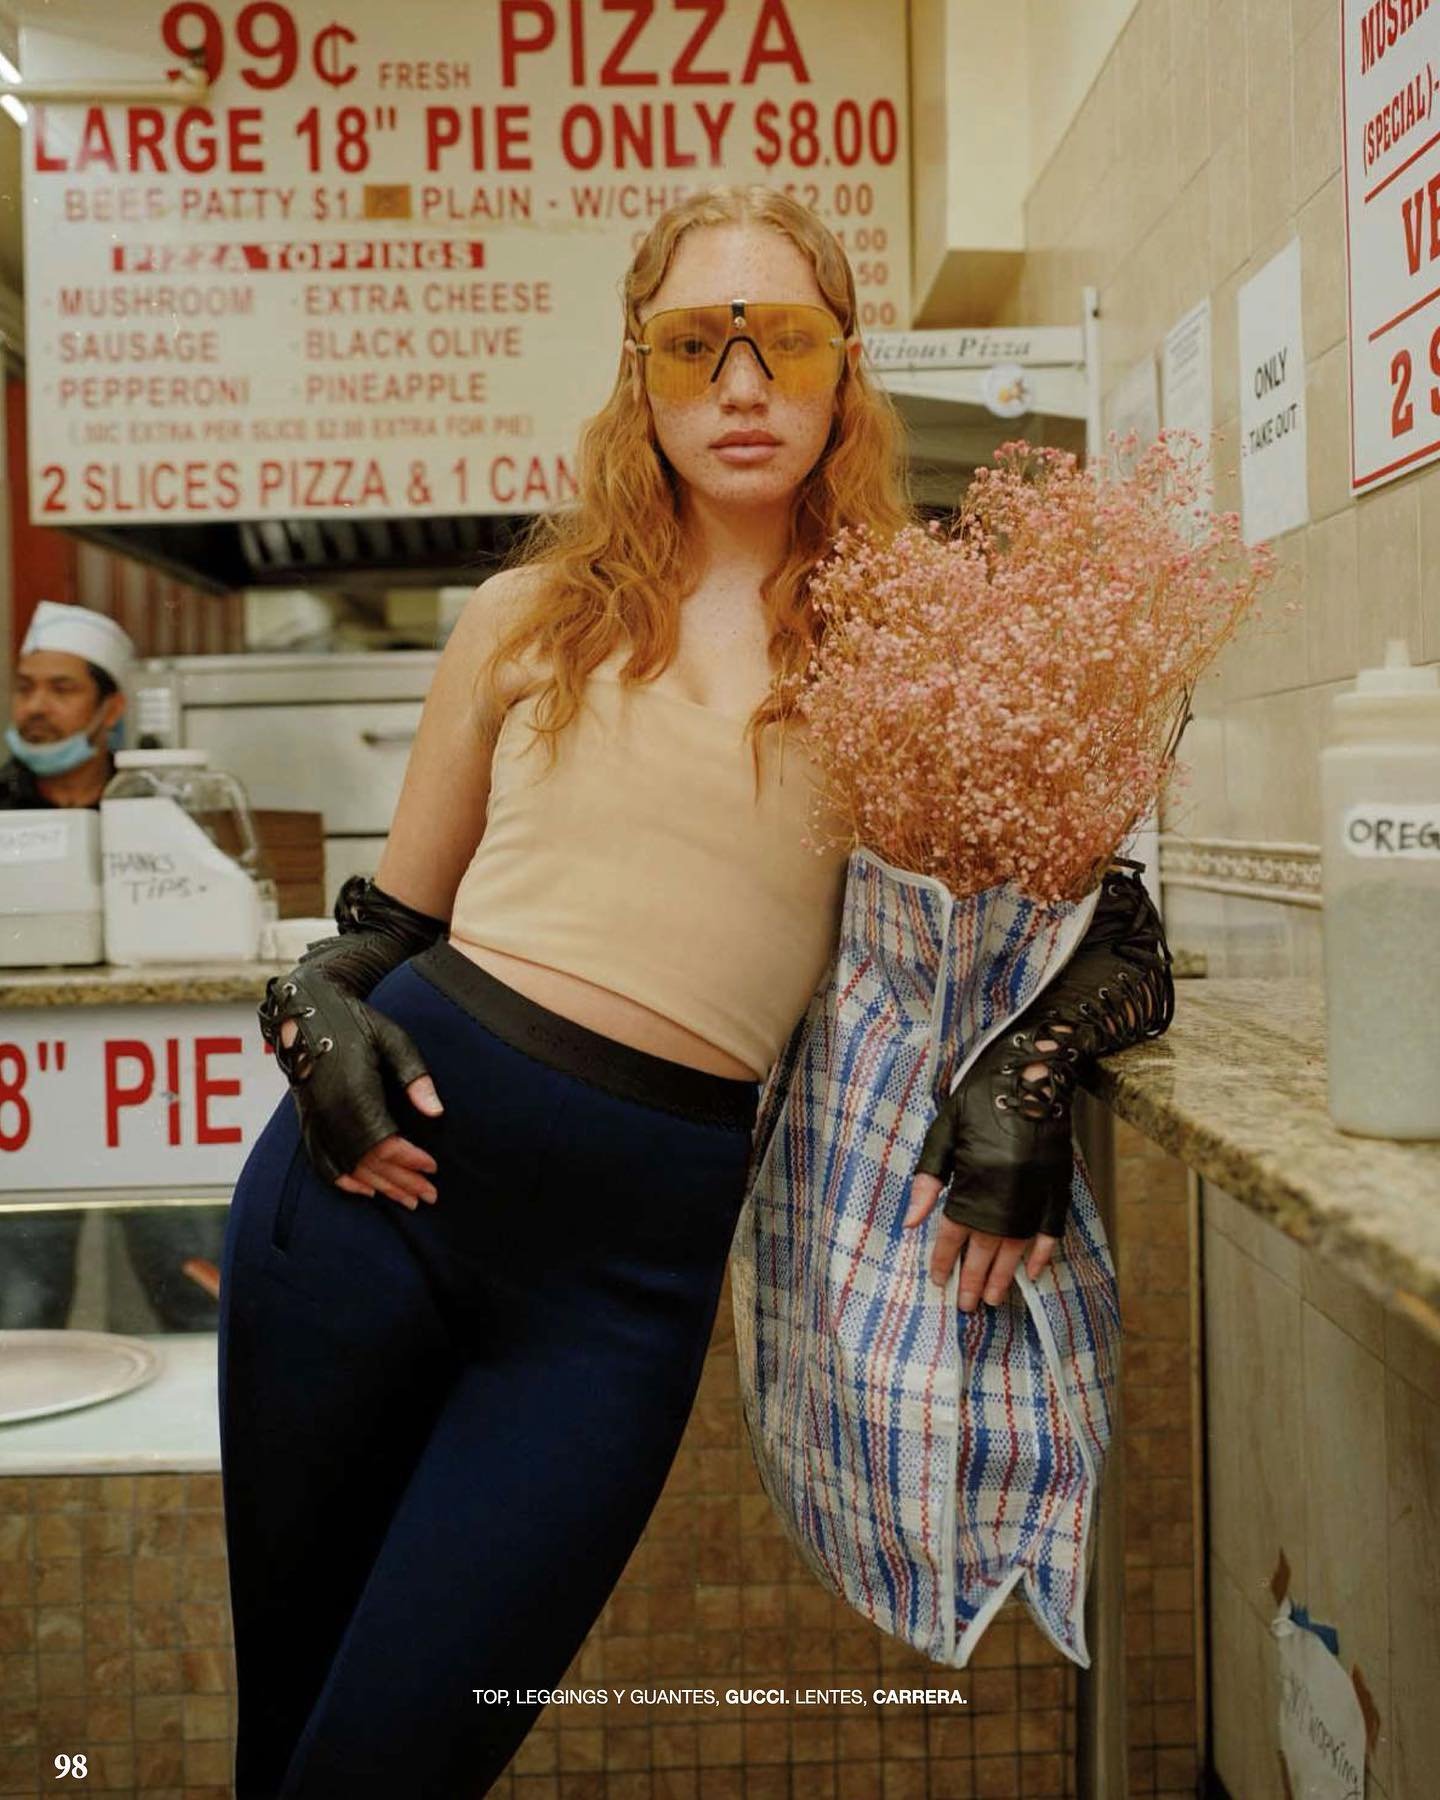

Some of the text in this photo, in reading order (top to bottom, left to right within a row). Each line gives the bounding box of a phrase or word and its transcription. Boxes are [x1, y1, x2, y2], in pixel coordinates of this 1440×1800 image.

[379, 62, 470, 88] FRESH
[501, 0, 810, 87] PIZZA
[34, 98, 898, 173] LARGE 18" PIE ONLY $8.00
[65, 188, 164, 222] BEEF
[181, 187, 295, 220] PATTY
[422, 185, 532, 219] PLAIN
[259, 241, 471, 271] TOPPINGS
[59, 282, 552, 318] MUSHROOM EXTRA CHEESE
[59, 327, 522, 363] SAUSAGE BLACK OLIVE
[957, 334, 1031, 358] Pizza
[59, 373, 487, 410] PEPPERONI PINEAPPLE
[1254, 346, 1287, 400] ONLY
[1391, 349, 1414, 439] 2
[1249, 403, 1297, 455] TAKE OUT
[41, 455, 580, 514] 2 SLICES PIZZA & 1 CAN
[105, 1037, 243, 1148] PIE
